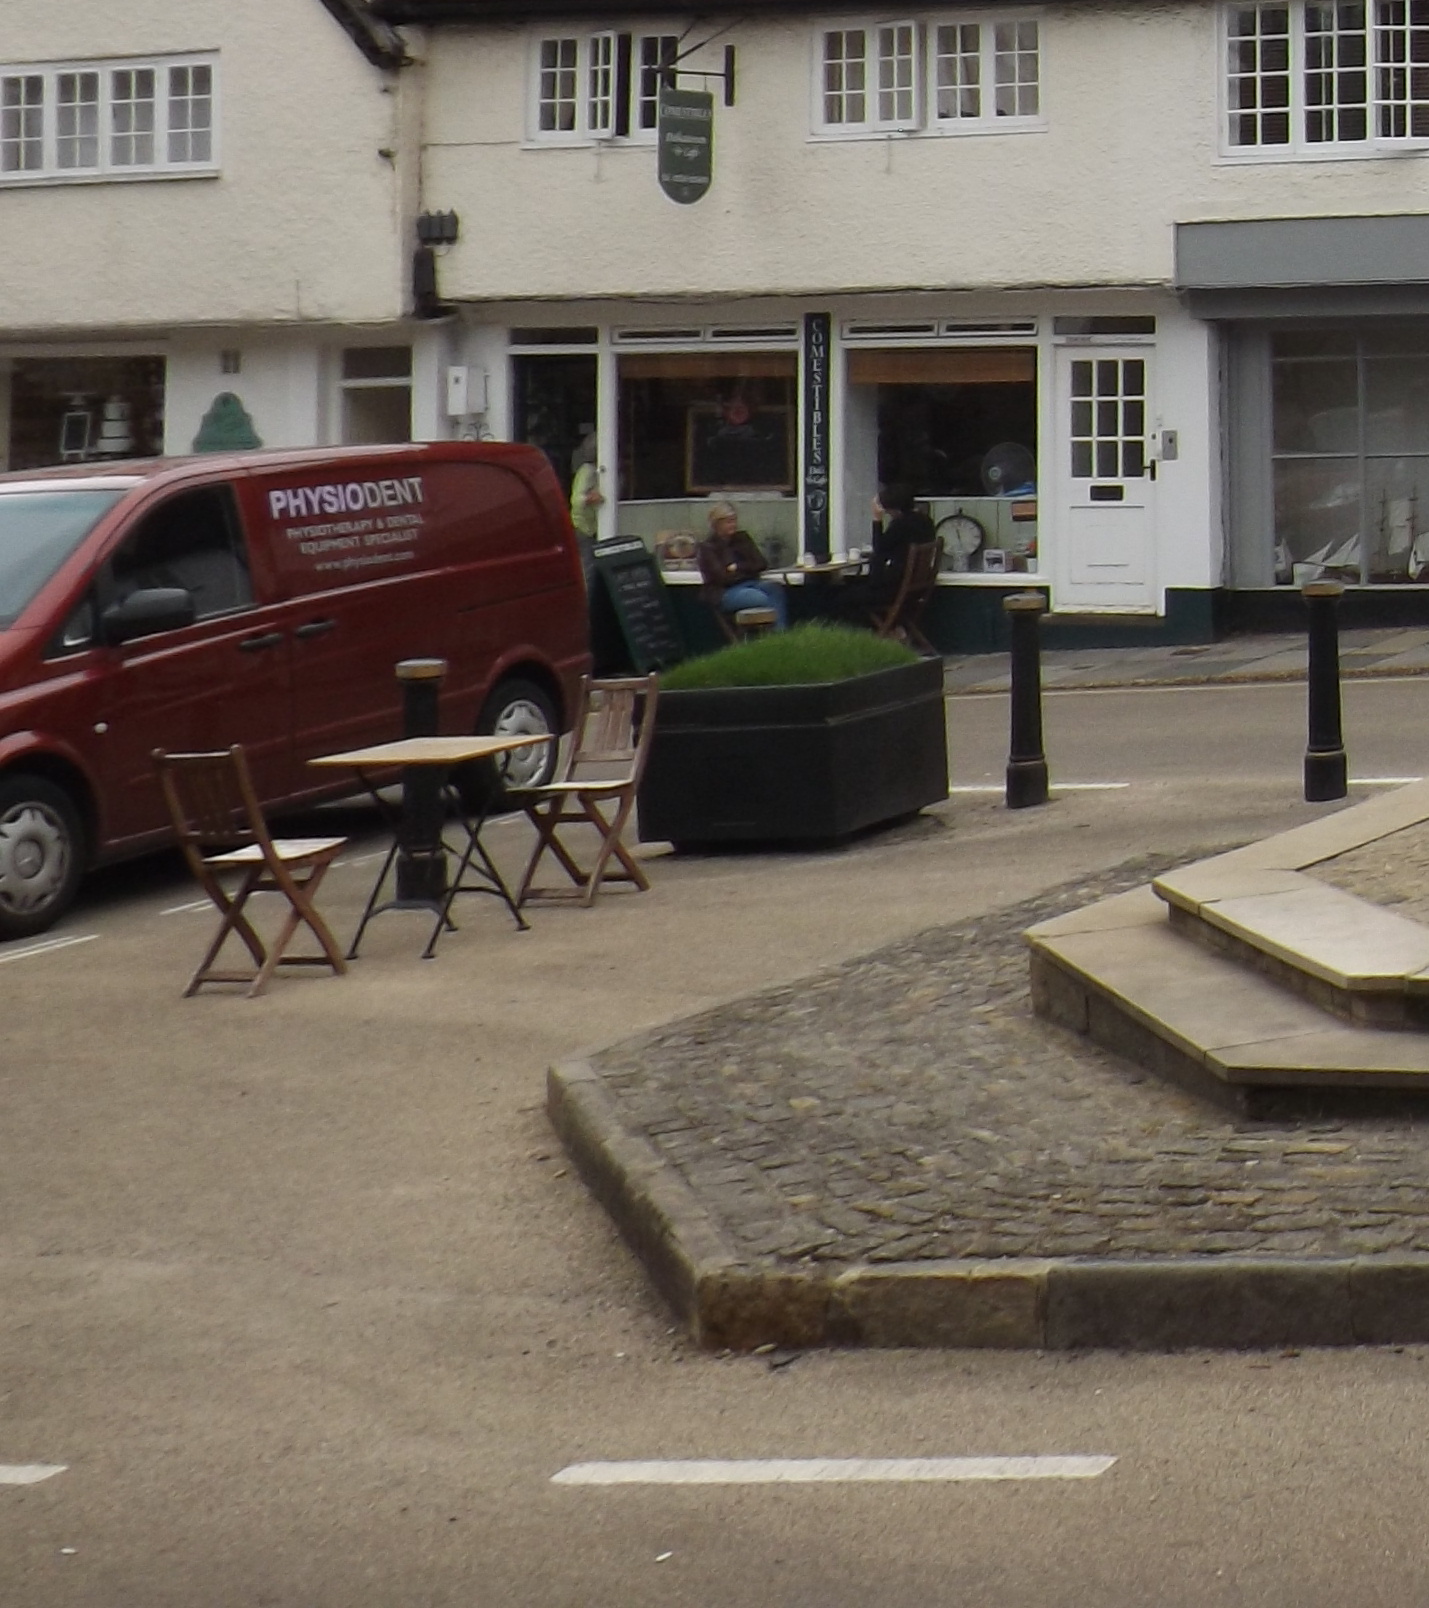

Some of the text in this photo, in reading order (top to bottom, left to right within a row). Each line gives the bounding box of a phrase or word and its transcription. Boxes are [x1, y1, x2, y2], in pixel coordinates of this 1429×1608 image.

[810, 318, 825, 464] COMESTIBLES
[269, 477, 424, 520] PHYSIODENT
[286, 514, 424, 539] PHYSIOTHERAPY & DENTAL
[299, 529, 419, 554] EQUIPMENT SPECIALIST
